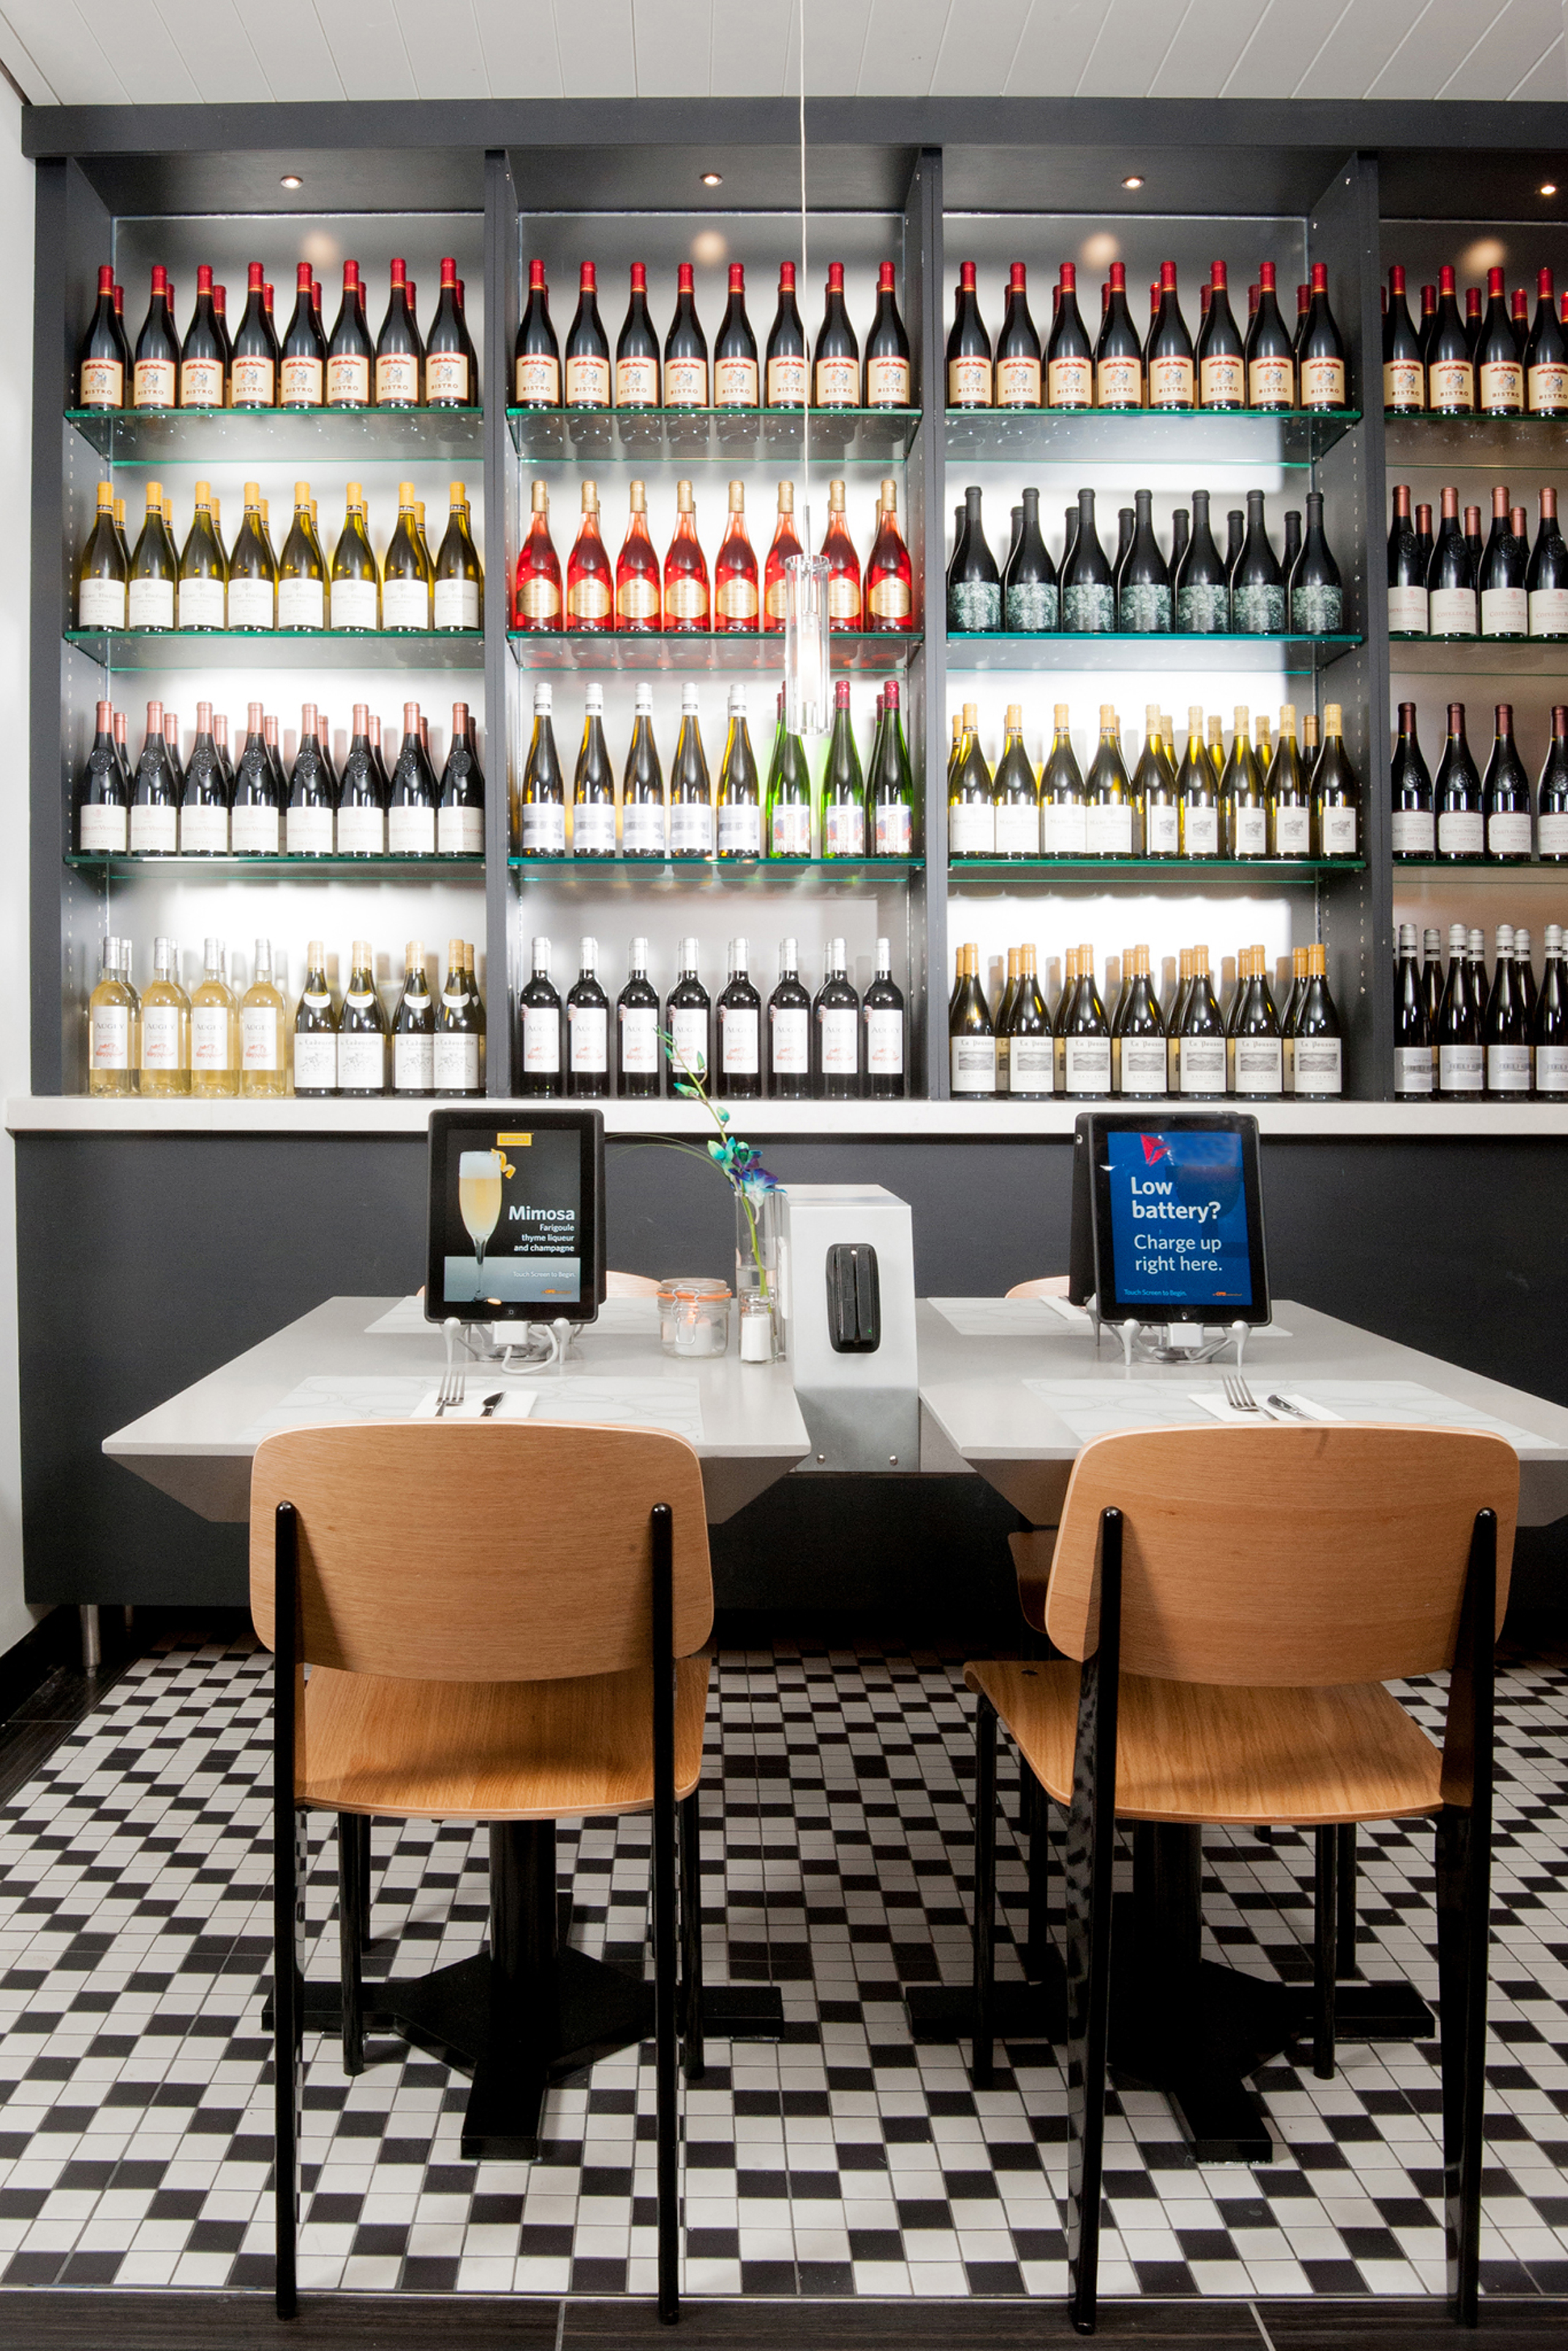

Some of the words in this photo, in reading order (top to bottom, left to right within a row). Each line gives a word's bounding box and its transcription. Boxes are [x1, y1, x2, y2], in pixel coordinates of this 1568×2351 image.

[1131, 1176, 1173, 1195] Low
[508, 1206, 575, 1221] Mimosa
[1132, 1200, 1221, 1223] battery?
[540, 1223, 575, 1233] Farigoule
[522, 1233, 546, 1243] thyme
[548, 1233, 575, 1243] liqueur
[1134, 1234, 1196, 1253] Charge
[1200, 1238, 1222, 1253] up
[530, 1244, 575, 1253] champagne
[1136, 1256, 1175, 1274] right
[1180, 1256, 1223, 1271] here.
